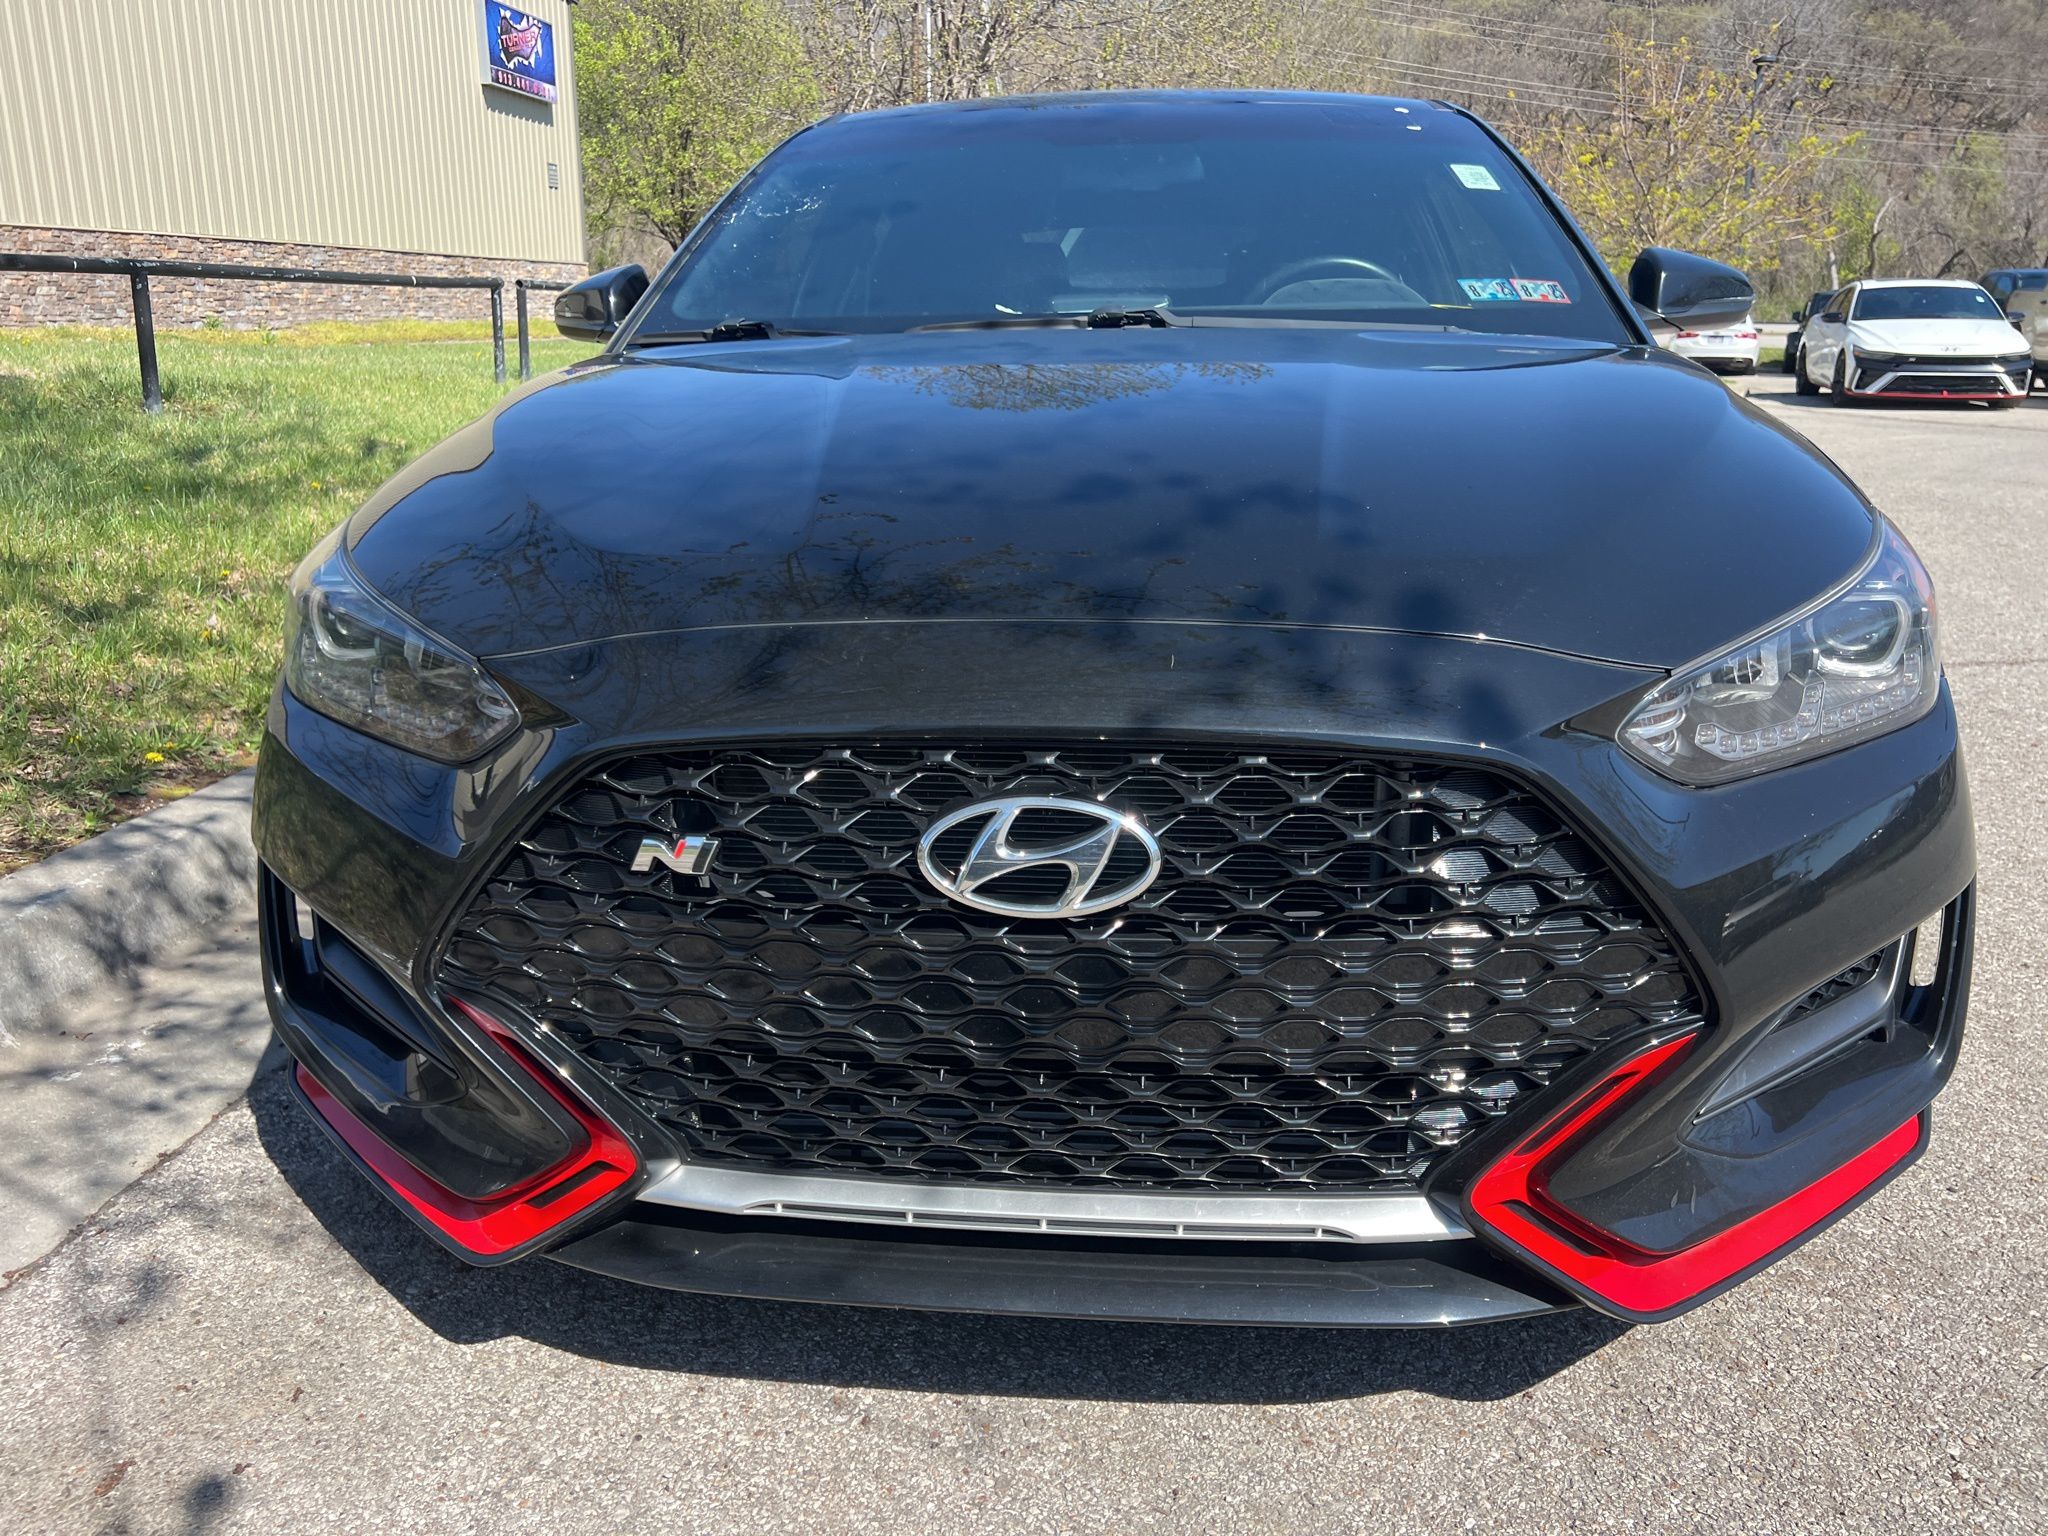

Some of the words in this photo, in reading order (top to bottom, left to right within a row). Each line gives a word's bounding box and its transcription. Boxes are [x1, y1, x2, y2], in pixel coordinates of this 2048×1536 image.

[1468, 285, 1481, 297] 8
[1496, 281, 1514, 296] 25
[1520, 284, 1532, 297] 8
[1548, 284, 1566, 299] 25
